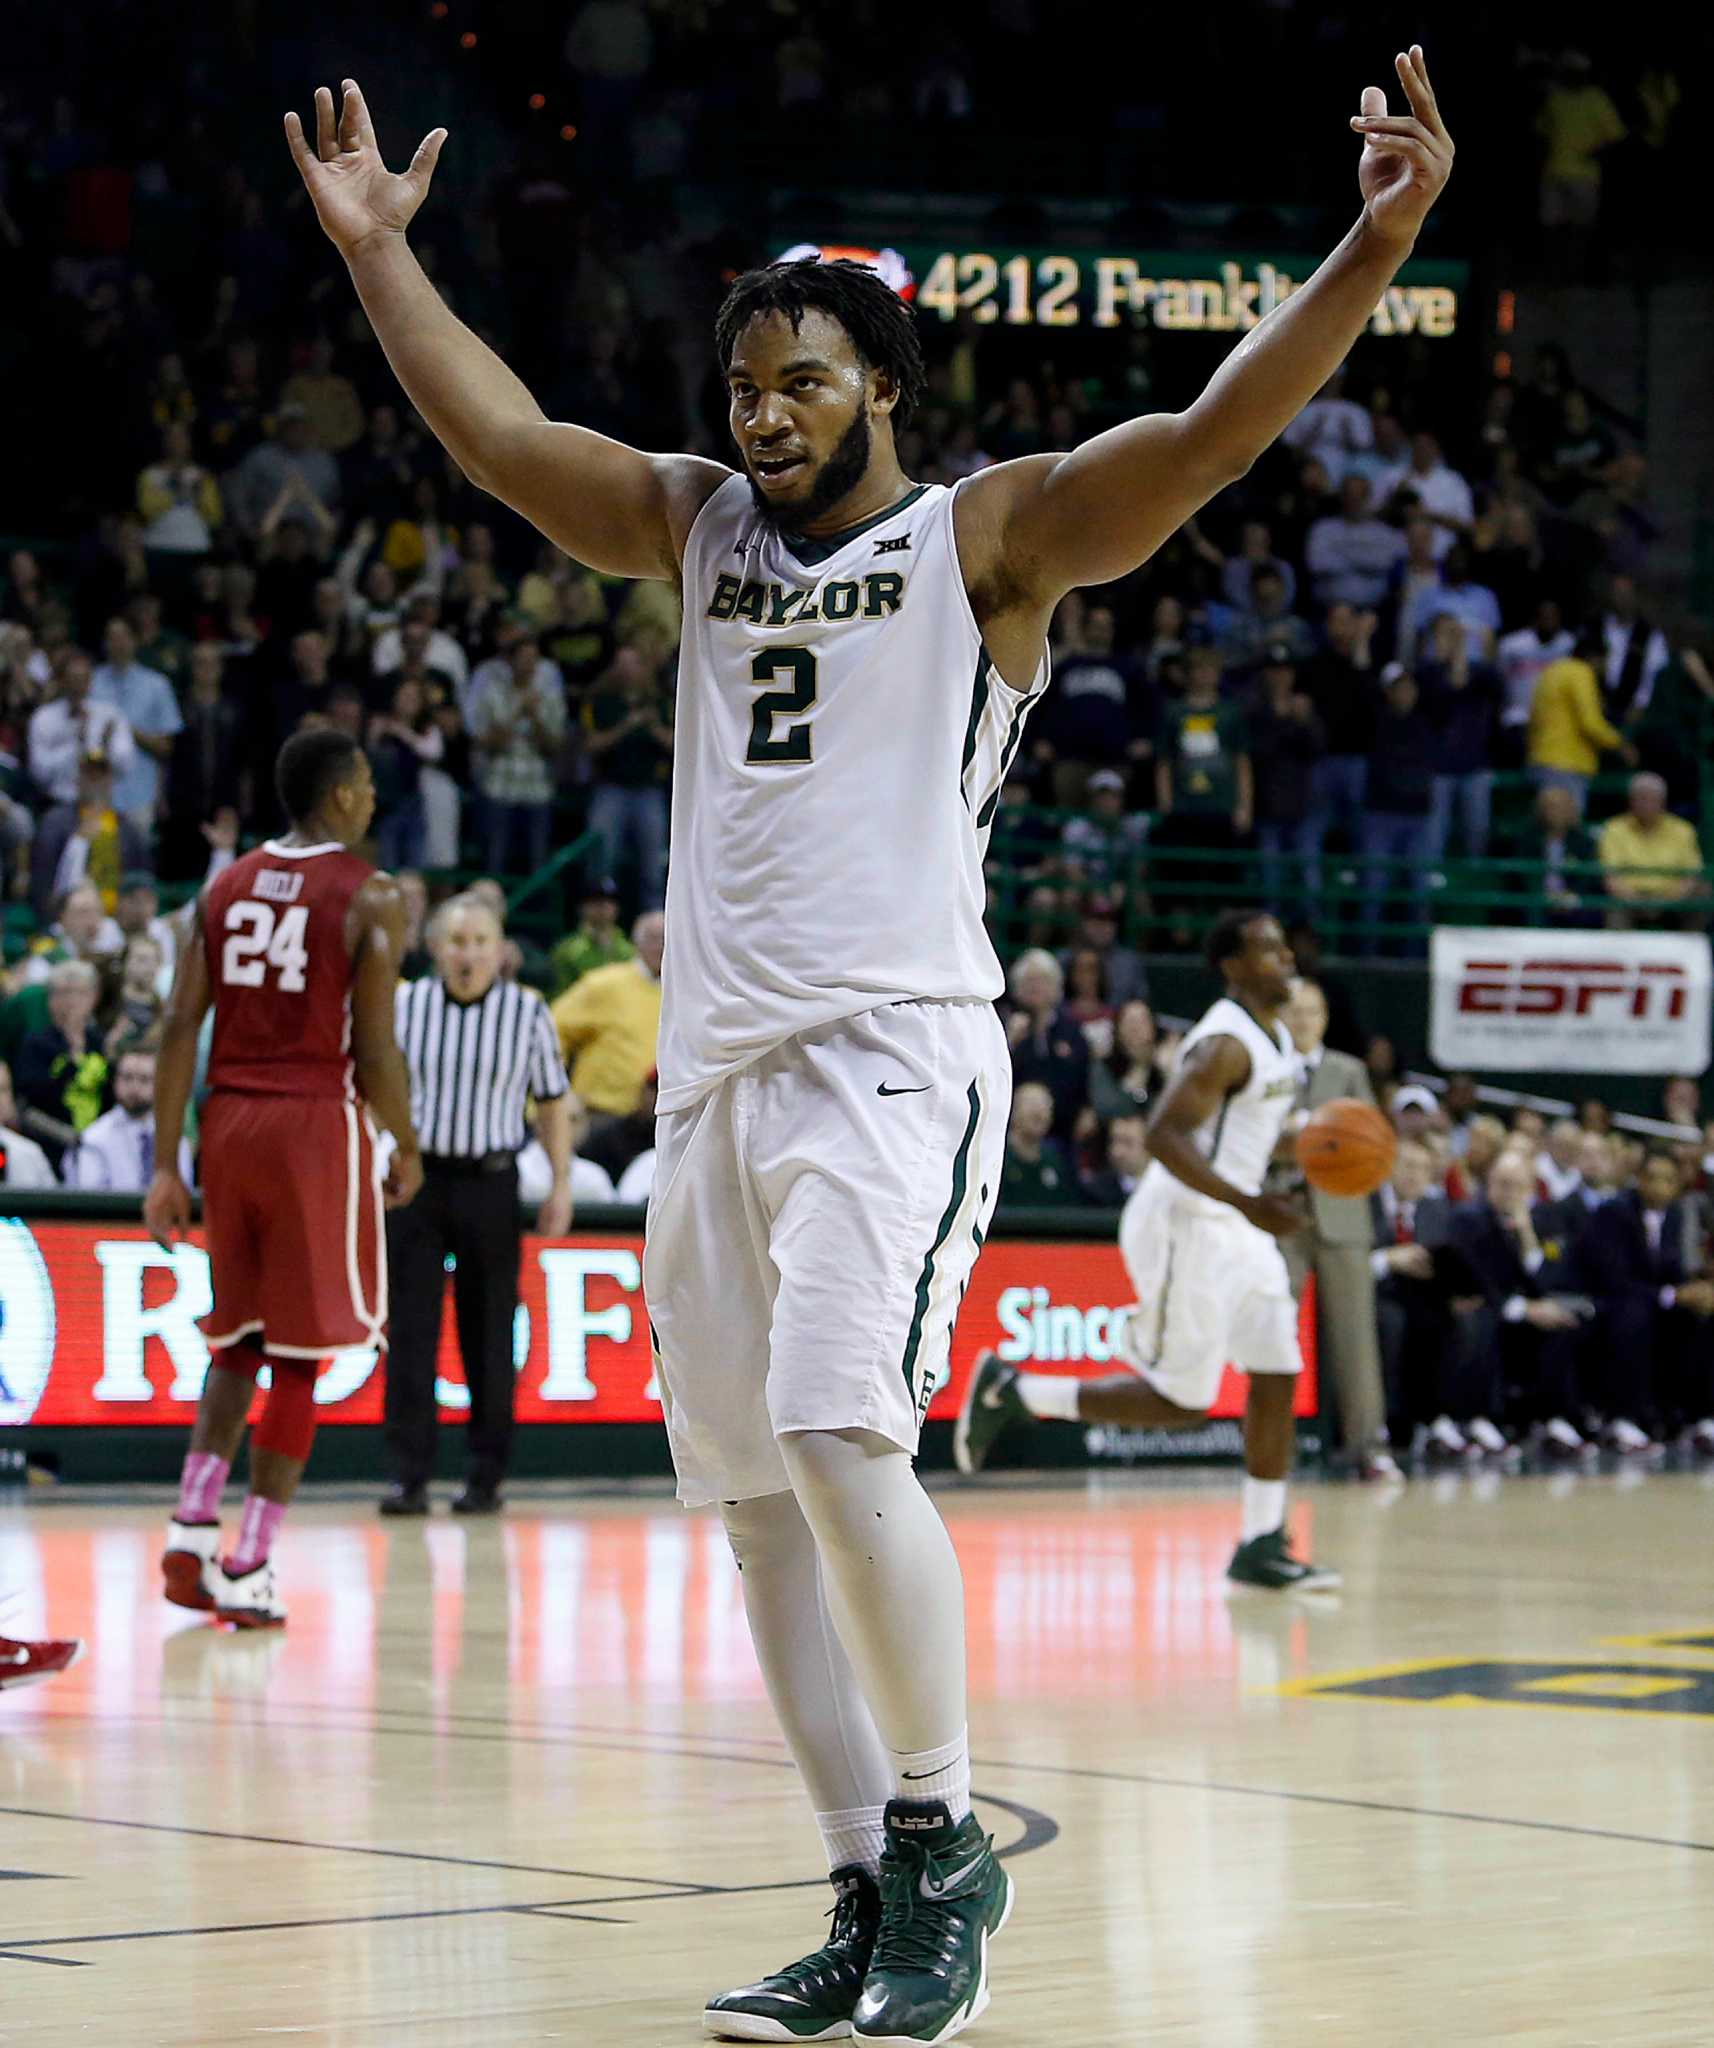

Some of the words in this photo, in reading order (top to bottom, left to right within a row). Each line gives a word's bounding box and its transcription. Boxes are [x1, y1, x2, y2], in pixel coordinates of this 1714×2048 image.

[918, 252, 1080, 326] 4212
[704, 569, 907, 628] BAYLOR
[744, 645, 818, 766] 2
[222, 899, 310, 993] 24
[1457, 961, 1685, 1021] ESPN
